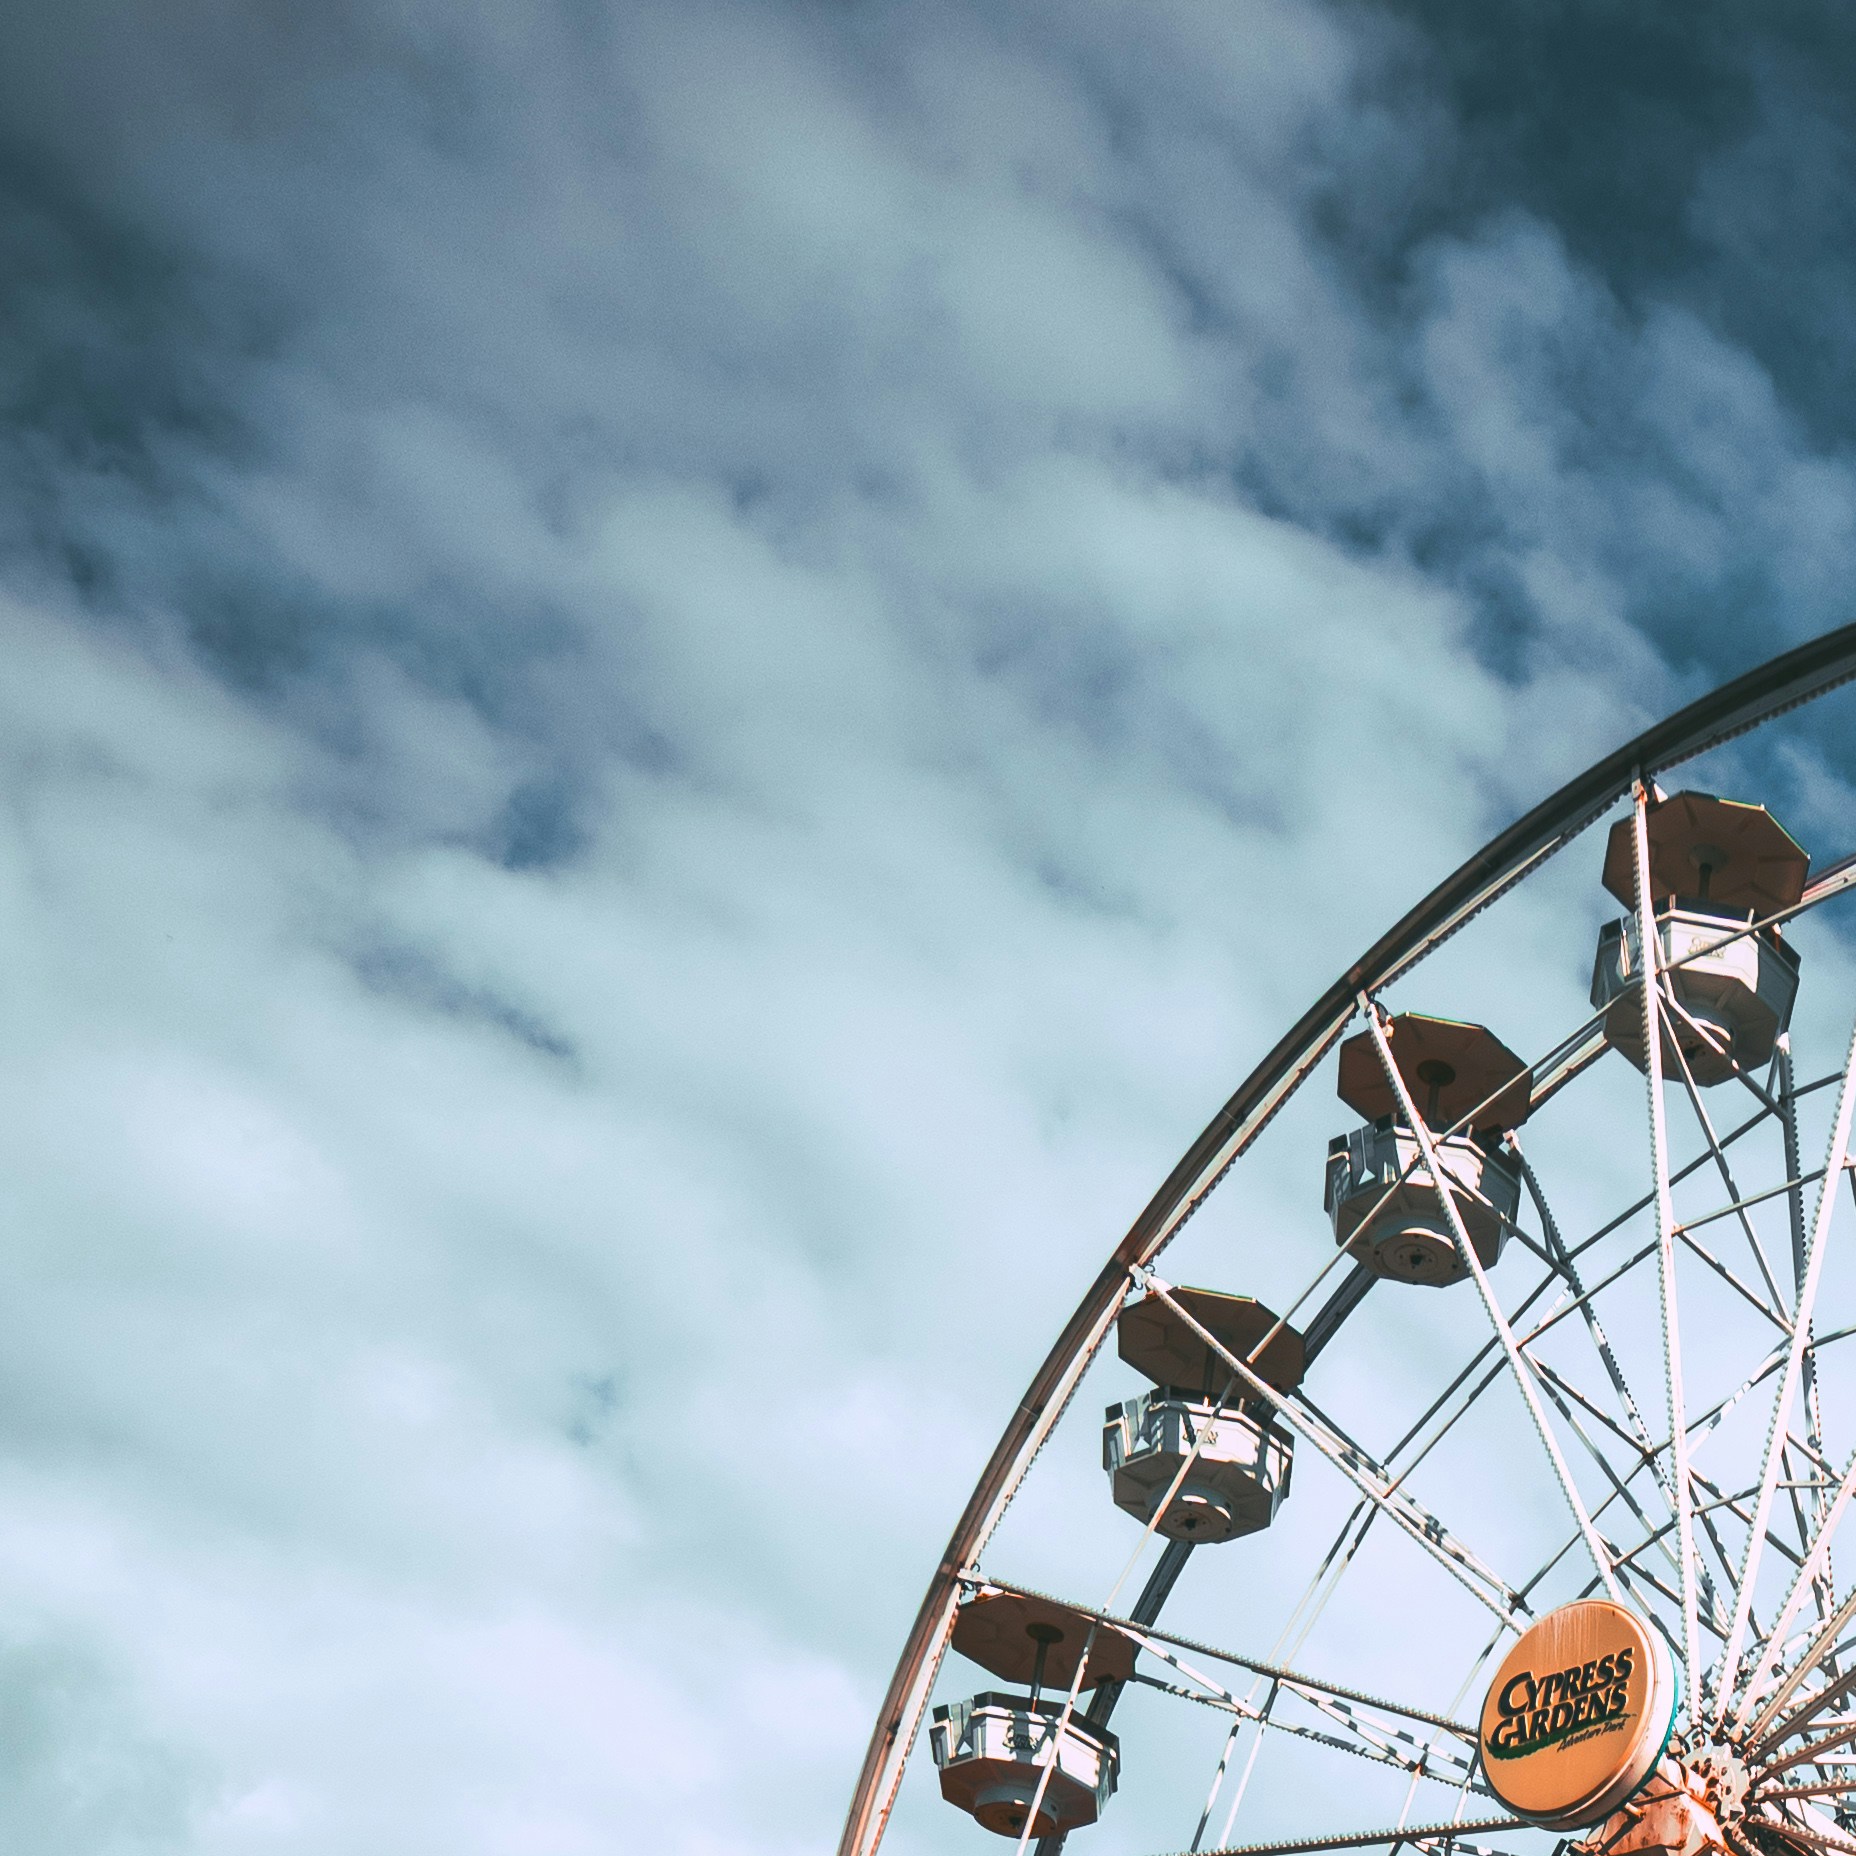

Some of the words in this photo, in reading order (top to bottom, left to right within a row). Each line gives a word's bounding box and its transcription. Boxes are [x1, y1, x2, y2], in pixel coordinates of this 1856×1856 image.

[1490, 1681, 1629, 1749] GARDENS
[1497, 1646, 1635, 1718] CYPRESS
[1601, 1718, 1627, 1735] Park
